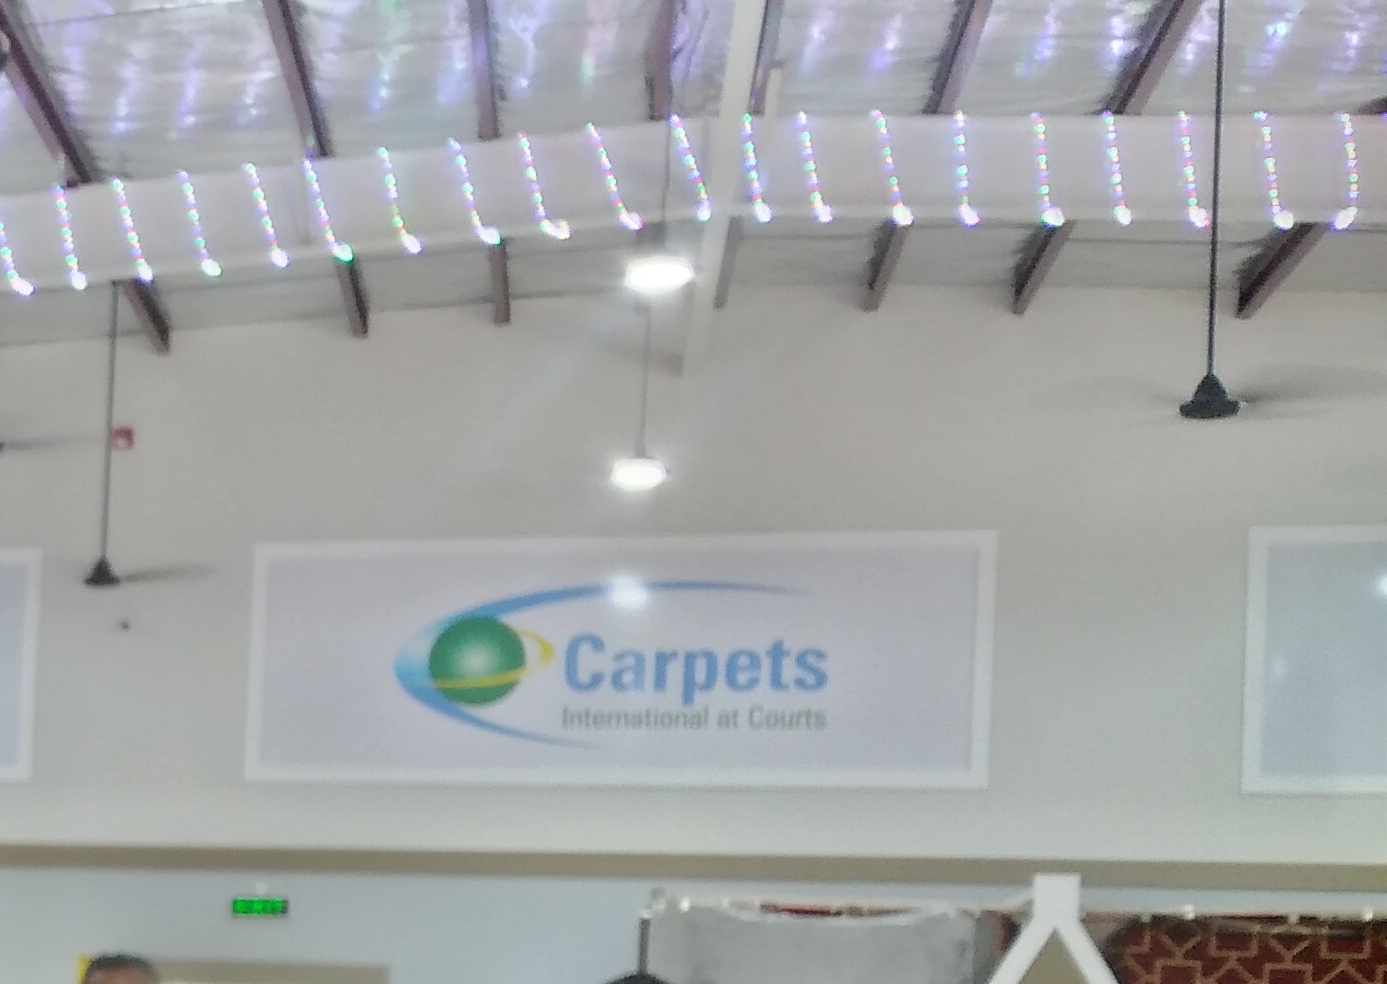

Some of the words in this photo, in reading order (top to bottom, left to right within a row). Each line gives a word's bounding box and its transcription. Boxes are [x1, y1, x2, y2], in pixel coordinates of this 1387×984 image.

[563, 632, 829, 706] Carpets
[561, 705, 710, 732] International
[717, 707, 740, 732] at
[748, 704, 827, 732] Courts
